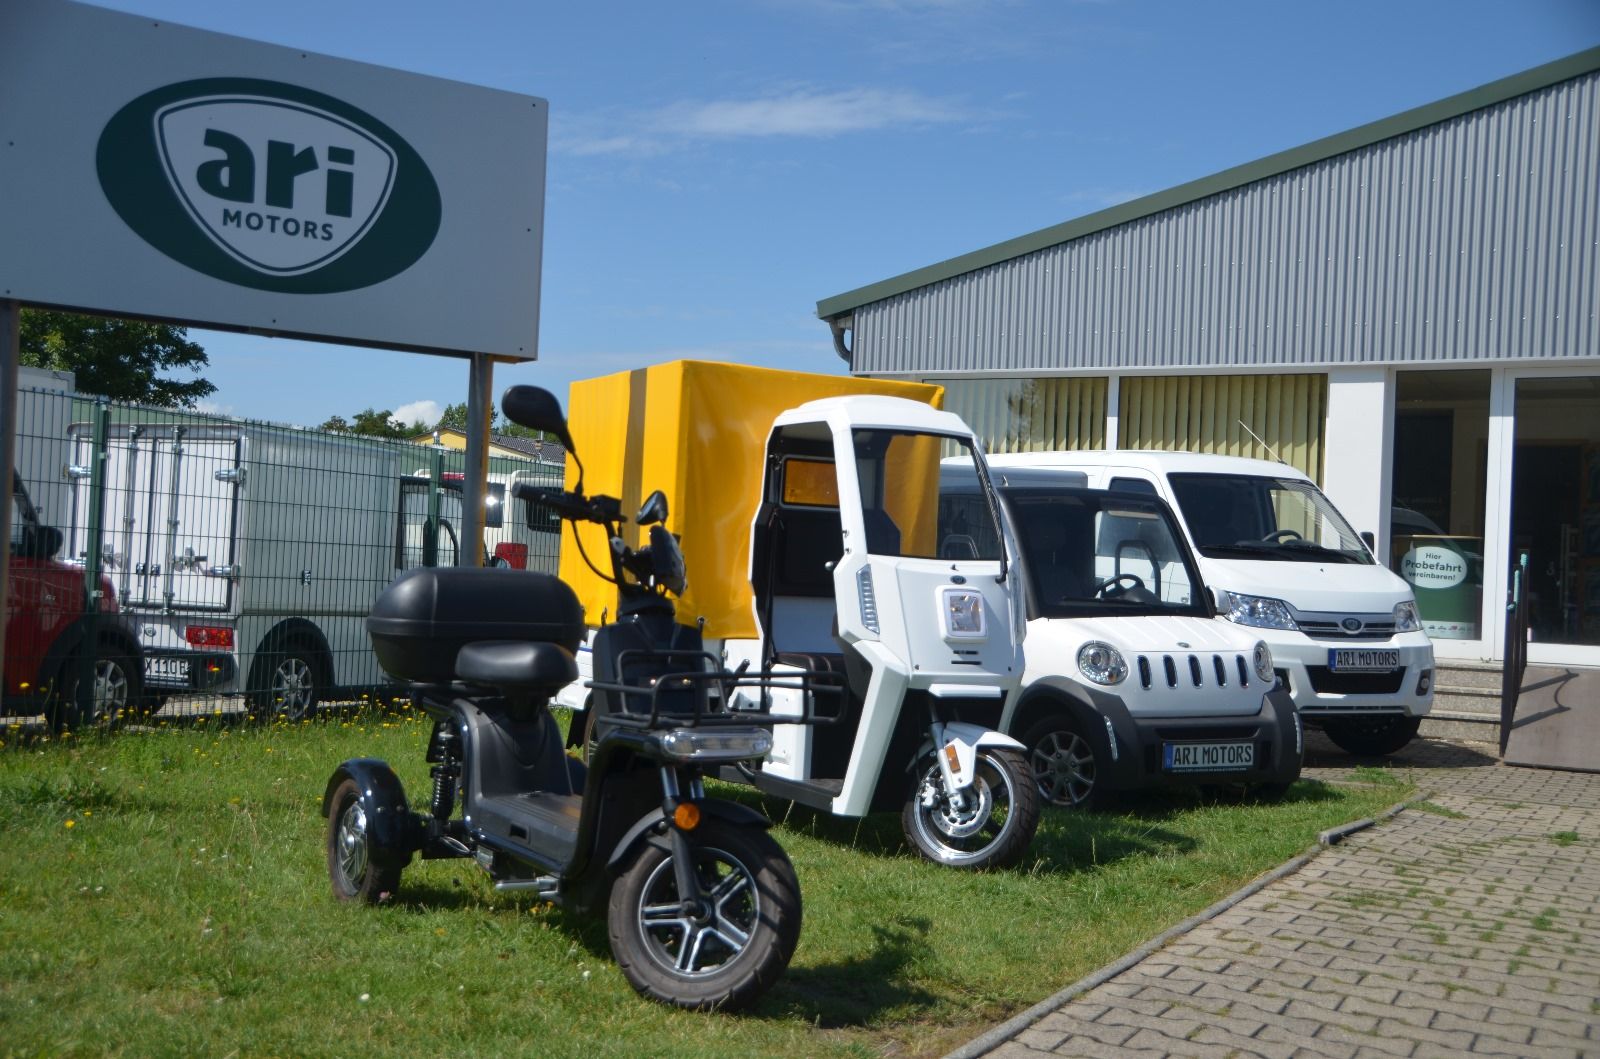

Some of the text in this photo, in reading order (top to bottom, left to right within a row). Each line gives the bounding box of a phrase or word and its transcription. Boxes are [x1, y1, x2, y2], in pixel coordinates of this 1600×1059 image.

[196, 128, 355, 218] ari
[222, 208, 334, 241] MOTORS
[1405, 560, 1462, 573] Probefahrt
[1408, 571, 1456, 581] vereinbaren!
[1336, 651, 1397, 666] ARI MOTORS
[1173, 745, 1252, 765] ARI MOTORS
